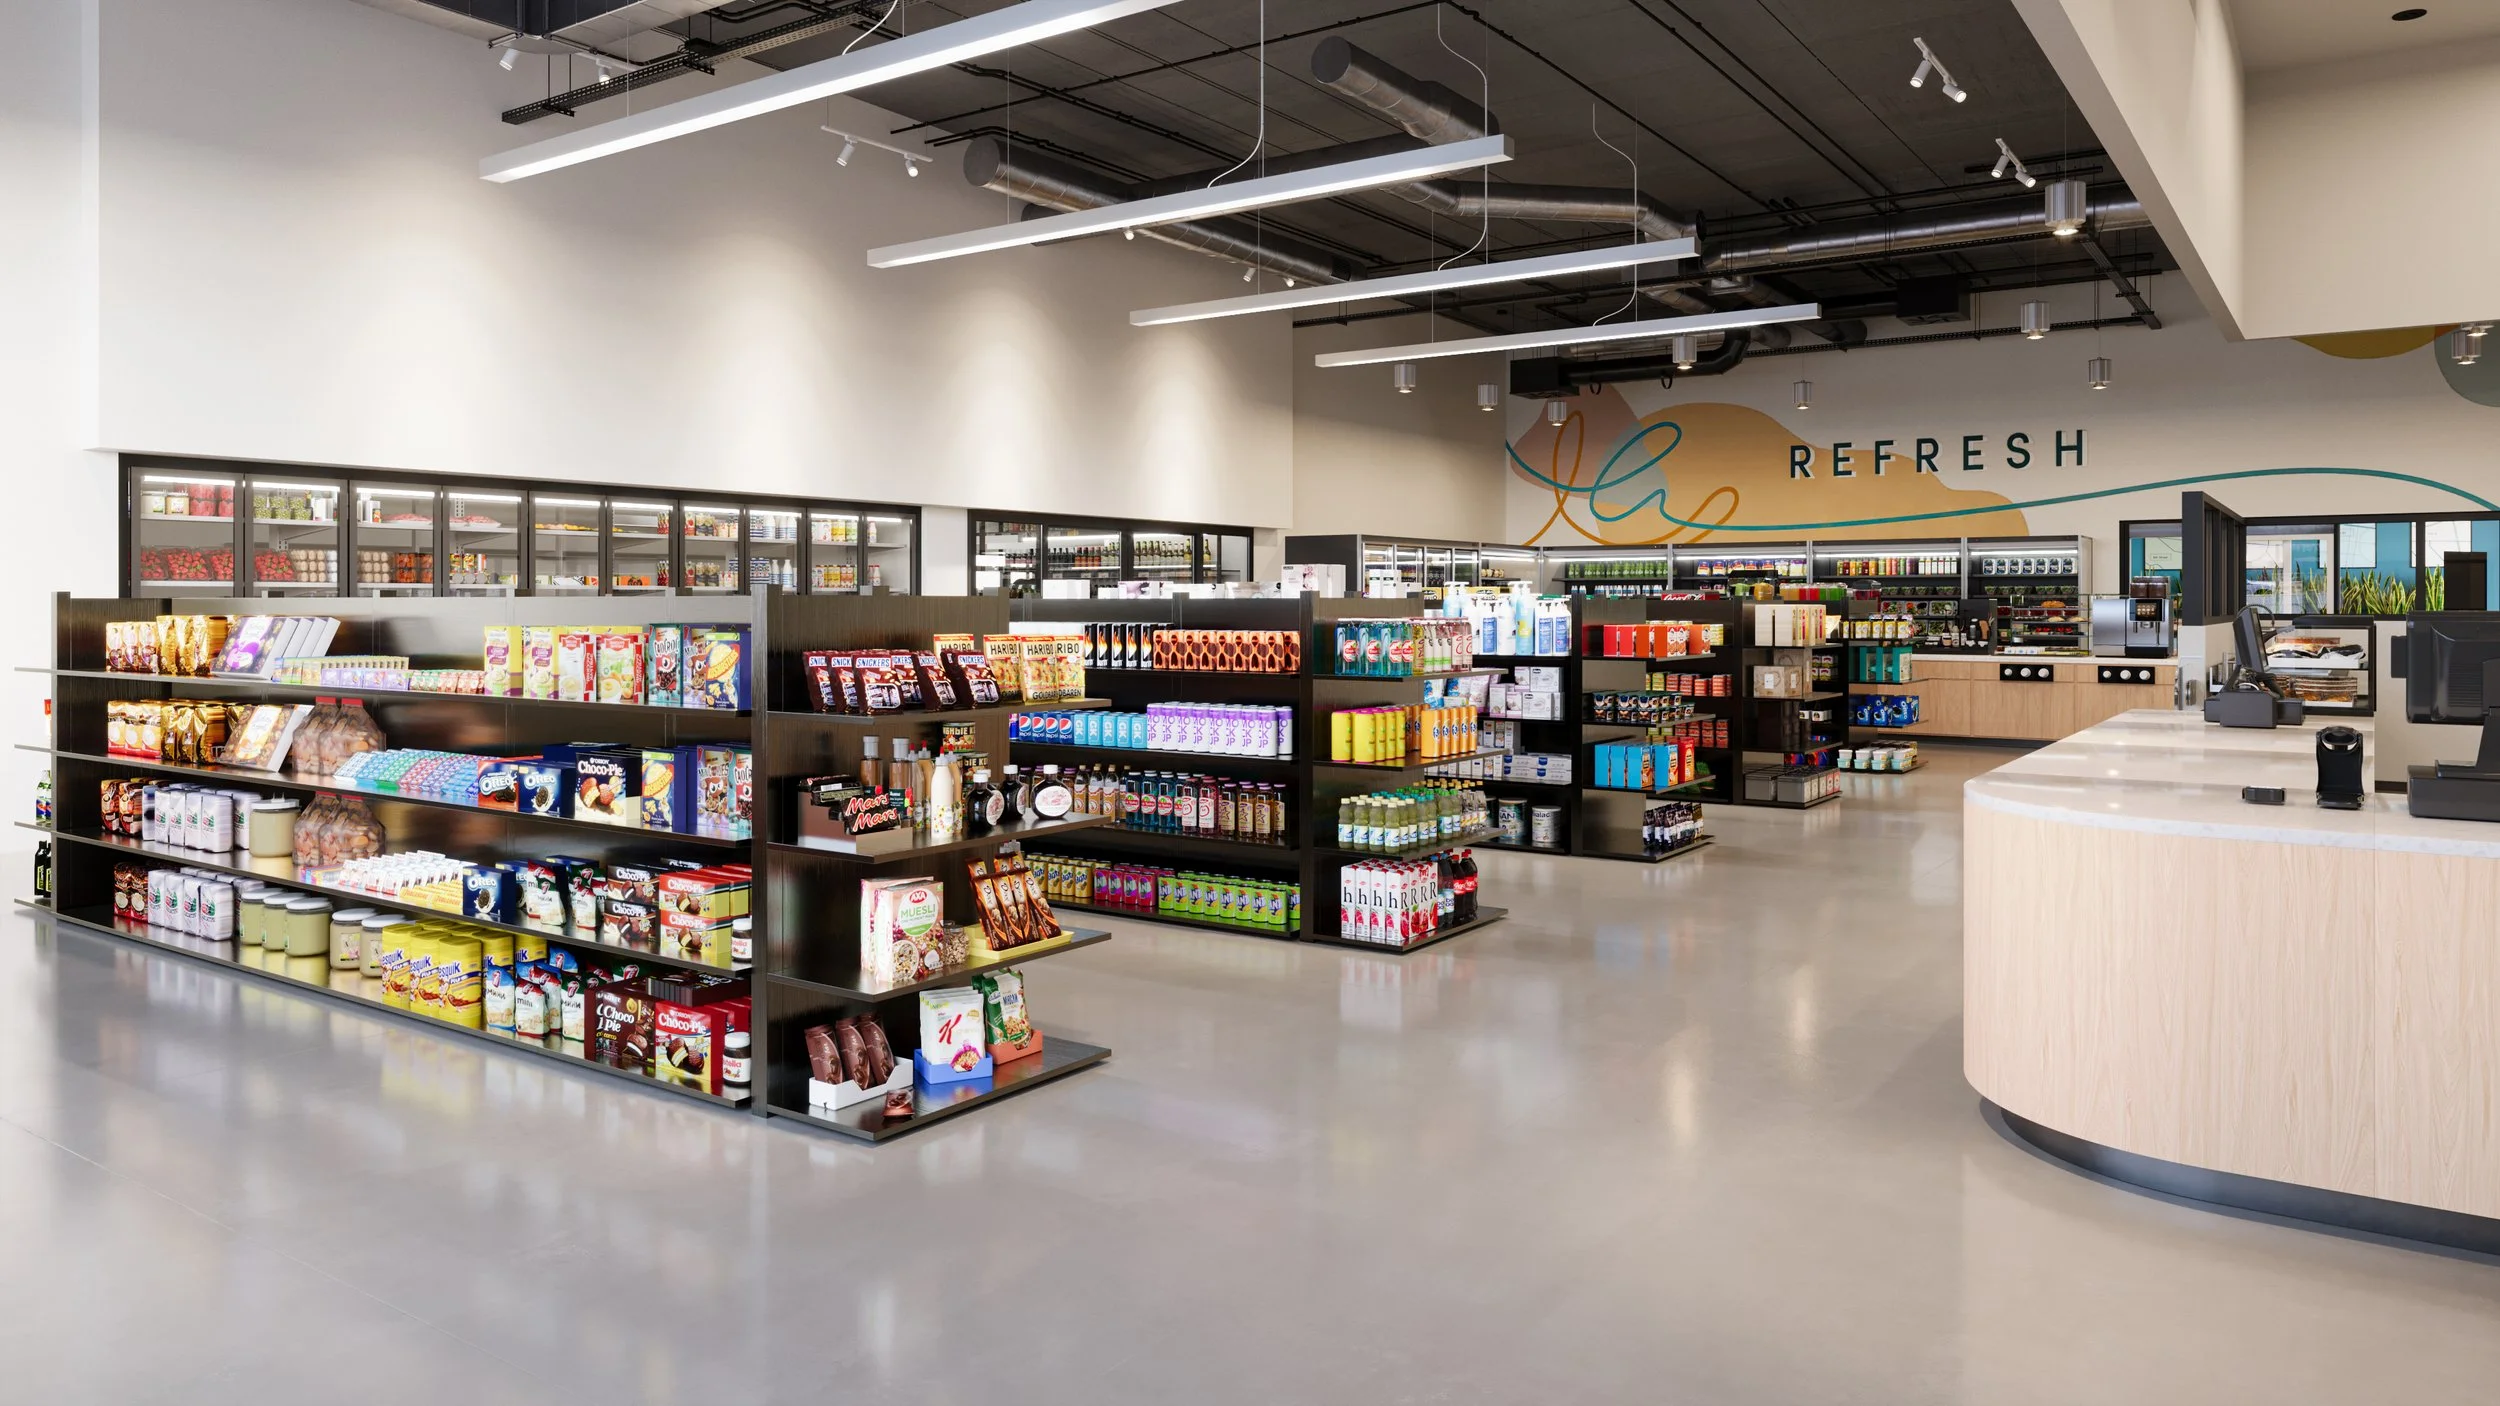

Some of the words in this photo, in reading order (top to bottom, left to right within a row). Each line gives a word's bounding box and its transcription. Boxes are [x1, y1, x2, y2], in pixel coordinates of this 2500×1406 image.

[1790, 429, 2084, 479] REFRESH
[1027, 645, 1053, 655] HARIBO
[1056, 643, 1079, 653] RIBO
[833, 657, 851, 666] SNICK
[857, 658, 890, 668] SNICKERS
[892, 656, 912, 665] ICKERS
[959, 655, 984, 665] SNICKERS
[578, 760, 624, 776] Choco-Pie
[480, 775, 514, 795] OREO
[525, 773, 555, 790] OREO
[845, 793, 889, 816] Mars
[853, 808, 898, 831] Mars
[468, 876, 497, 891] OREO
[911, 890, 927, 902] AXA
[900, 904, 936, 918] MUESLI
[603, 1005, 635, 1023] Choco
[605, 1020, 621, 1032] Pie
[658, 1013, 707, 1035] Choco-Pie
[938, 1013, 962, 1045] K
